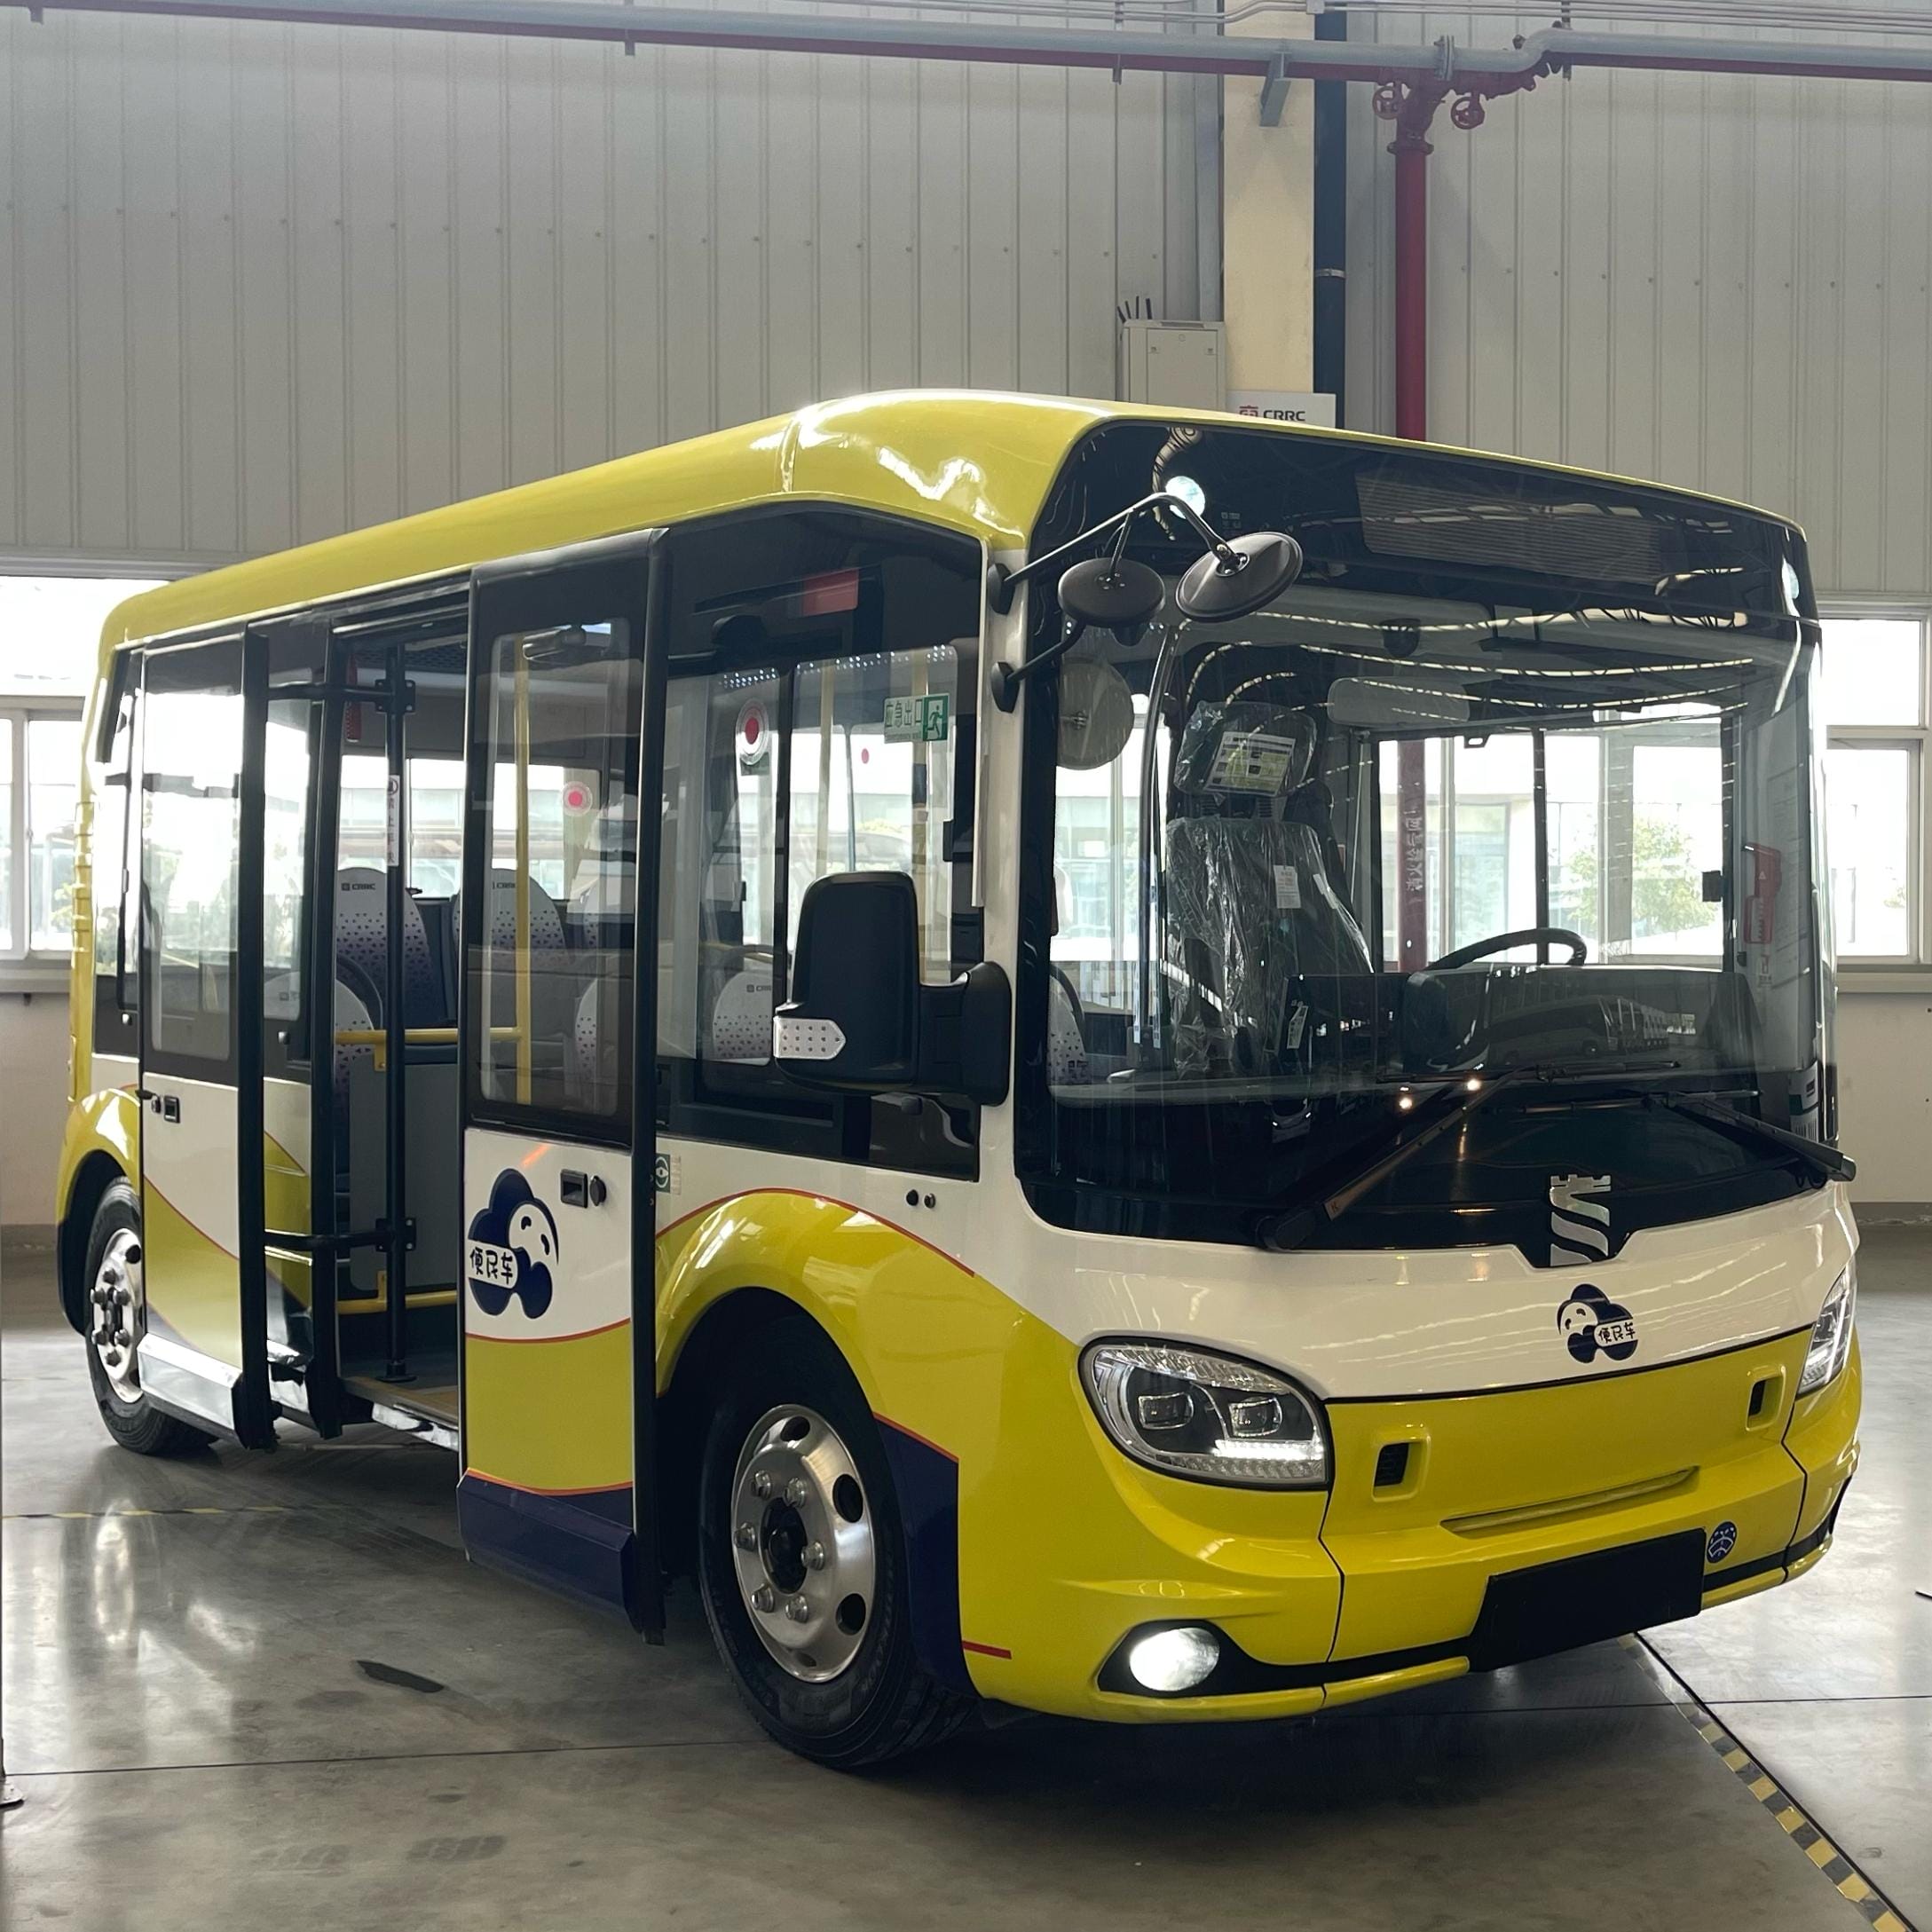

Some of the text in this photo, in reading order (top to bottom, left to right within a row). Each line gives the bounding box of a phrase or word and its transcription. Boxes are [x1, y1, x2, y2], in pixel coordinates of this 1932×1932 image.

[1264, 409, 1305, 422] CRRC
[469, 1246, 513, 1285] 便民车
[1598, 1321, 1636, 1344] 便民车
